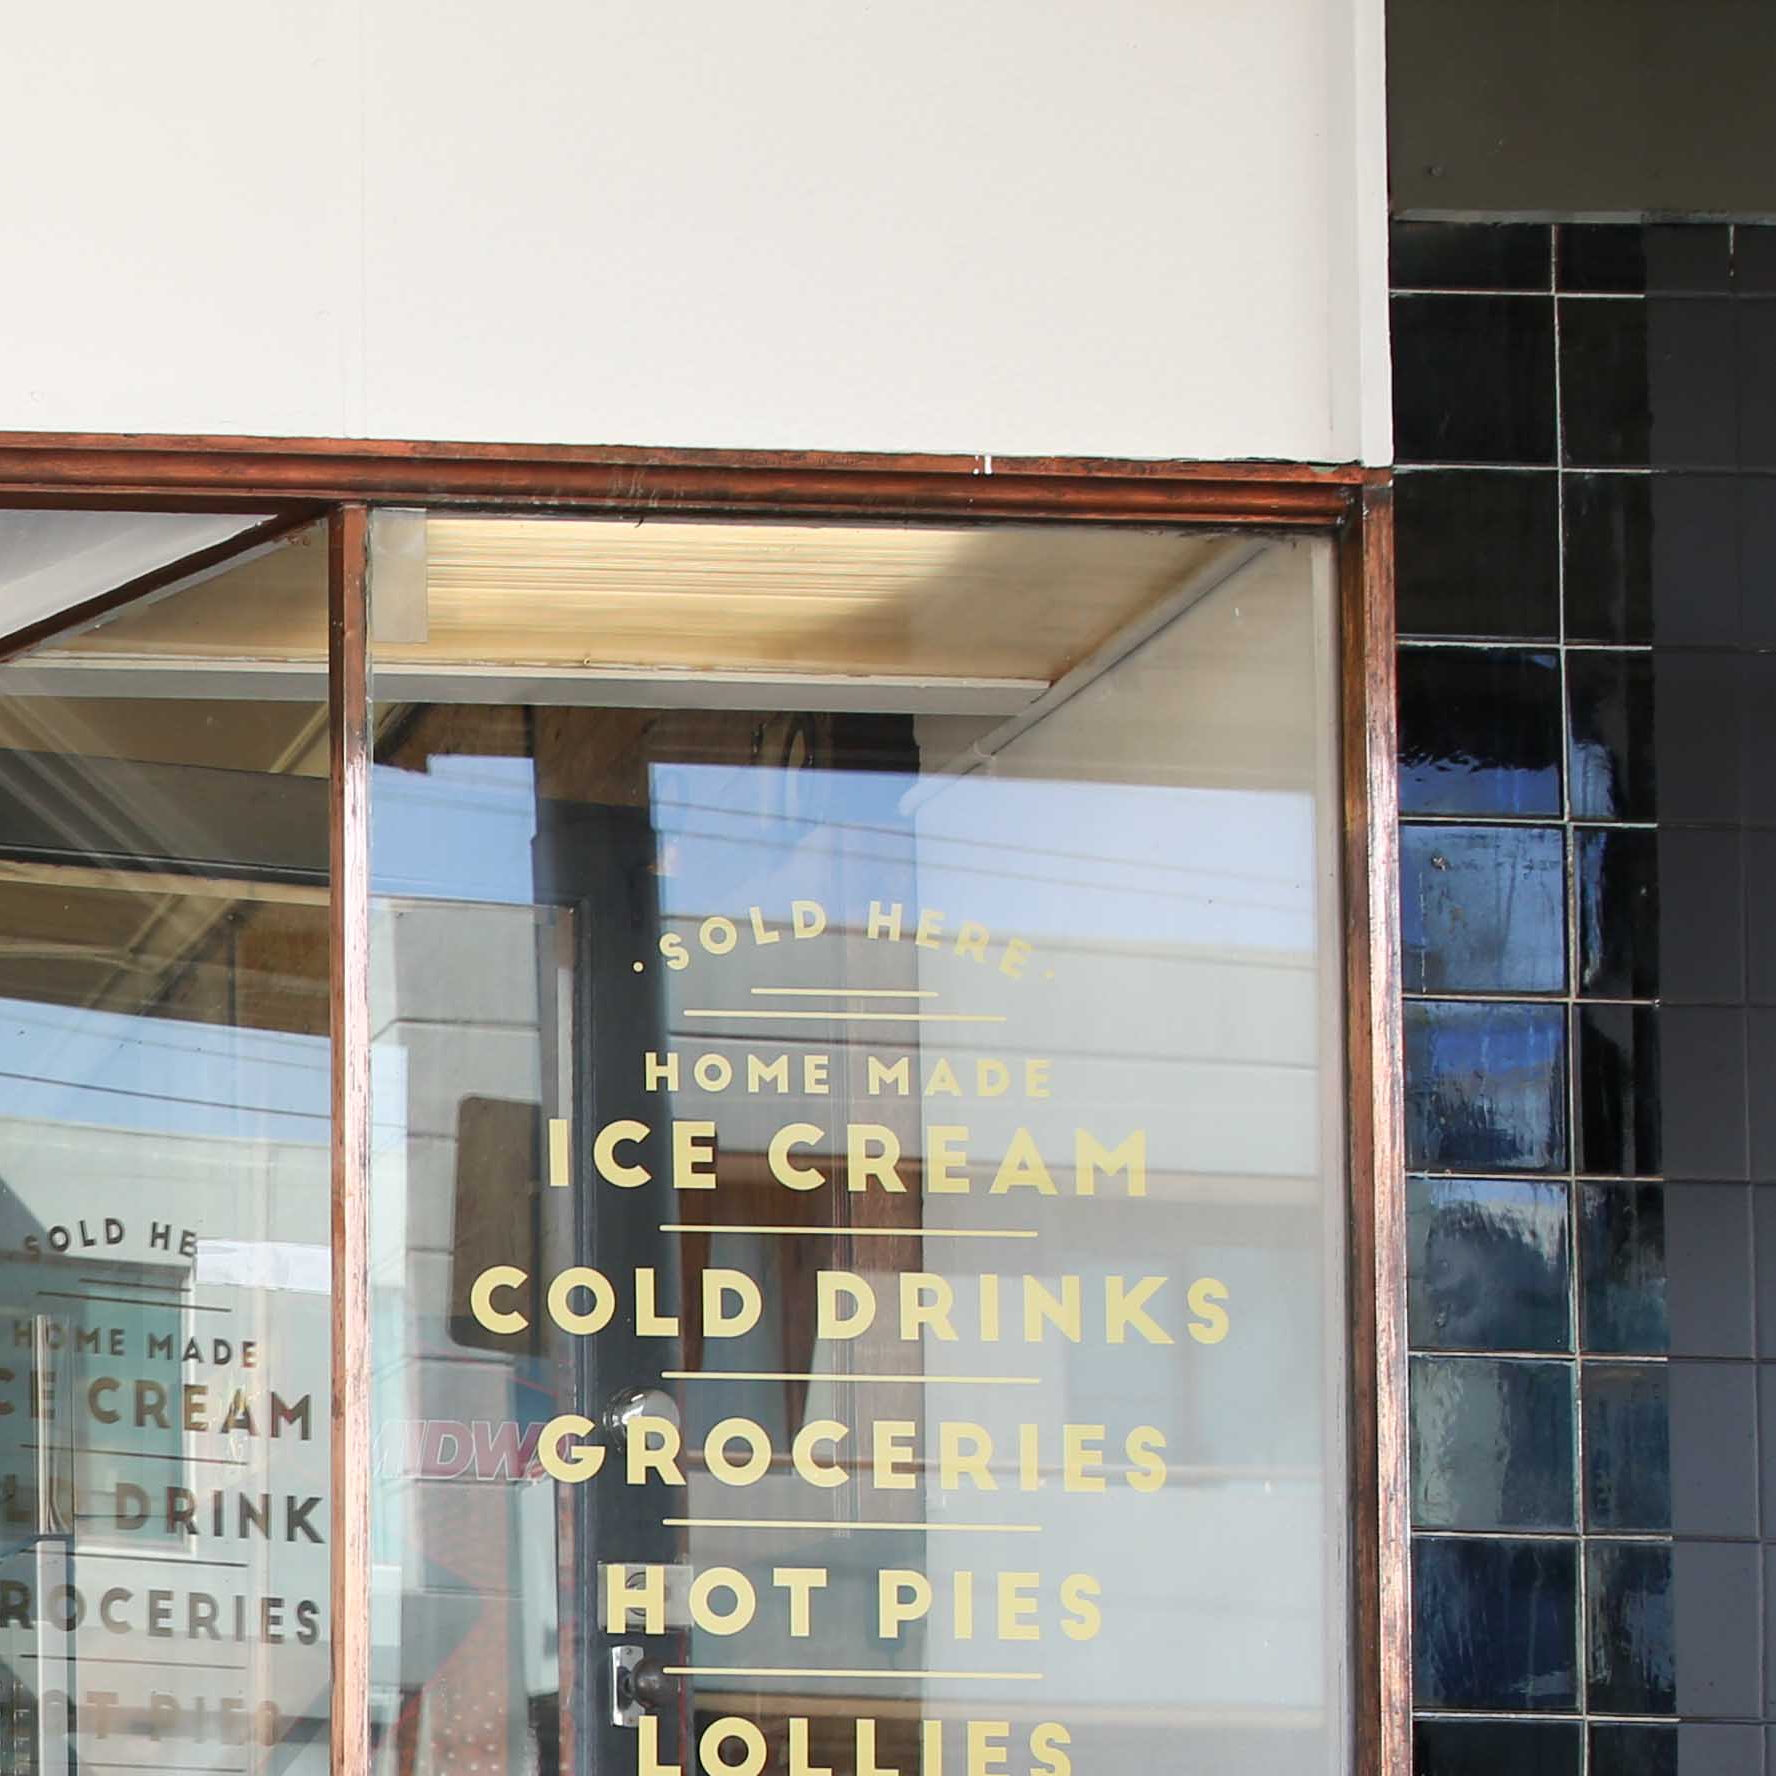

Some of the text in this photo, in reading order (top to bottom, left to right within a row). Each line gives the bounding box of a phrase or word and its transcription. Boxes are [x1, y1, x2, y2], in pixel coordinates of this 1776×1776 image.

[660, 900, 1034, 981] SOLD HERE
[645, 1050, 1053, 1099] HOME MADE
[548, 1118, 1148, 1198] ICE CREAM
[470, 1265, 1232, 1346] COLD DRINKS
[148, 1332, 259, 1369] MADE
[87, 1375, 312, 1442] CREAM
[537, 1414, 1169, 1493] GROCERIES
[115, 1481, 326, 1545] DRINK
[605, 1564, 1104, 1641] HOT PIES
